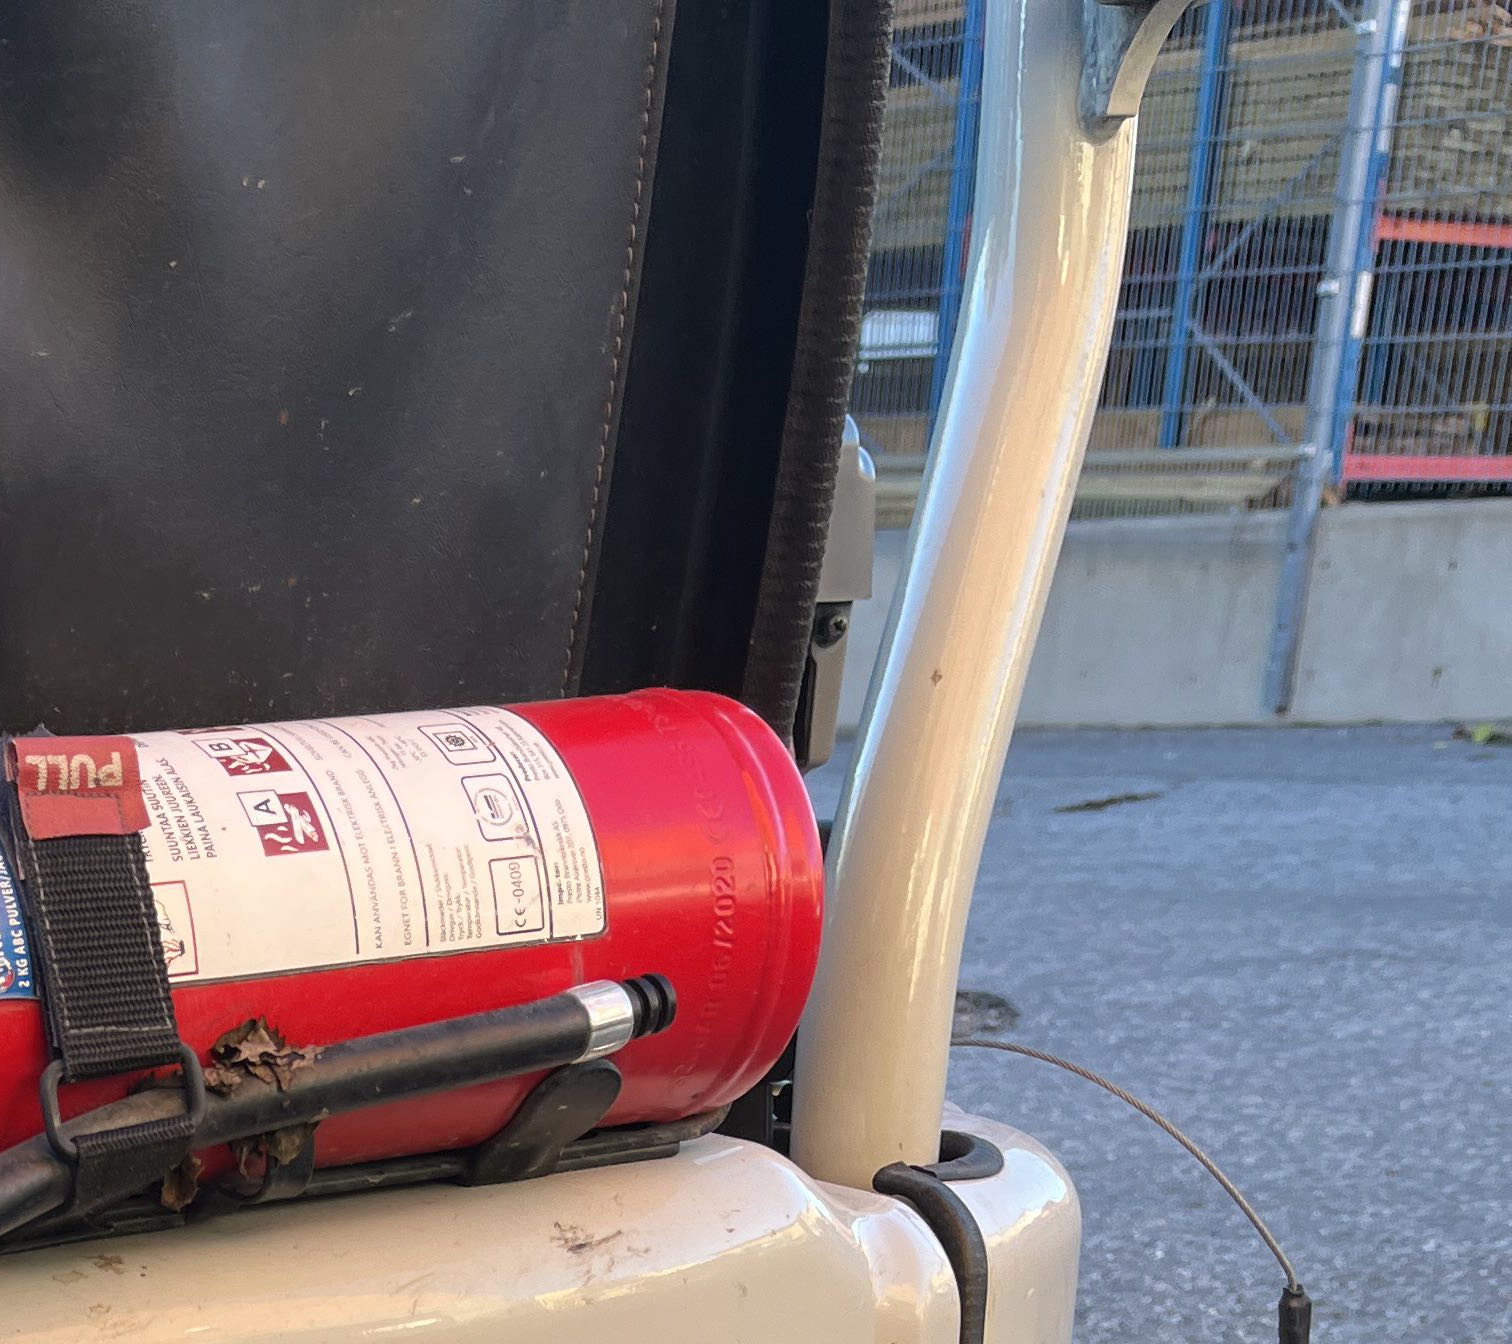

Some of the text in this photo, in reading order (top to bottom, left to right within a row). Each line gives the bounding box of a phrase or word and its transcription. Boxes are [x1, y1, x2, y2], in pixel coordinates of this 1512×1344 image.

[208, 741, 232, 751] B
[25, 752, 123, 791] PULL
[174, 775, 204, 828] LAUKAISIN
[253, 798, 276, 815] A
[156, 811, 183, 862] SUUNTAA
[173, 813, 200, 861] LIEKKIEN
[202, 828, 217, 859] PAINA
[360, 843, 371, 866] MOT
[392, 852, 405, 888] BRANN
[368, 865, 381, 927] ANVÄNDAS
[12, 929, 27, 955] ABC
[375, 927, 383, 949] KAN
[17, 959, 29, 976] KG
[18, 980, 30, 988] 2
